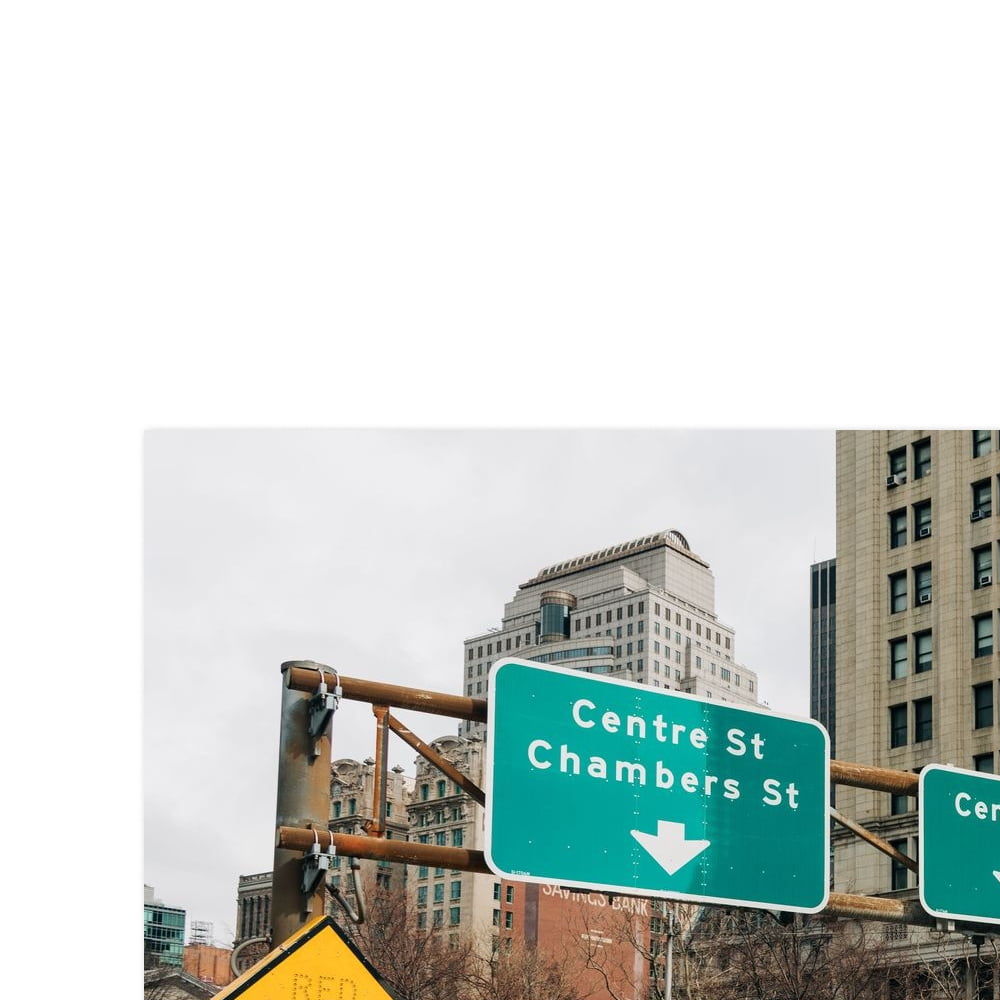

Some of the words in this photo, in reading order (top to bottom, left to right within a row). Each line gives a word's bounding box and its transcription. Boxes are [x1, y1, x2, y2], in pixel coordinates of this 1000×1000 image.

[572, 698, 708, 749] Centre
[726, 728, 766, 760] St
[527, 739, 741, 800] Chambers
[762, 778, 799, 809] St
[611, 895, 649, 917] BANK
